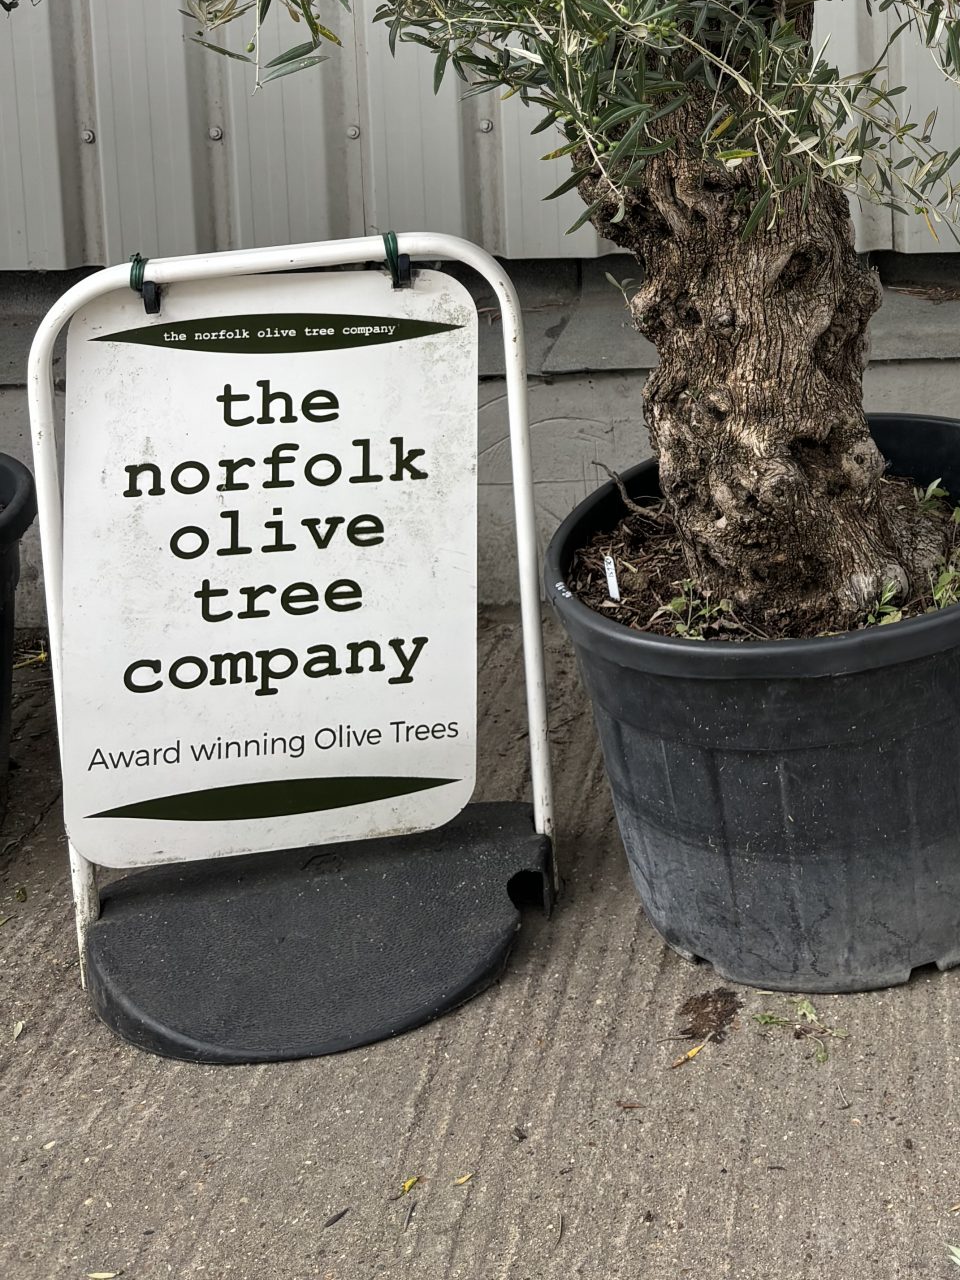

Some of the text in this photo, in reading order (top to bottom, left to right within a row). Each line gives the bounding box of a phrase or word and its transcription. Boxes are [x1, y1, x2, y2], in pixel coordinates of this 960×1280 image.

[163, 324, 396, 342] the norfolk olive tree company
[217, 380, 340, 426] the
[123, 437, 429, 497] norfolk
[170, 508, 385, 559] olive
[194, 579, 363, 622] tree
[124, 637, 429, 696] company
[87, 720, 459, 772] Award winning Olive Trees
